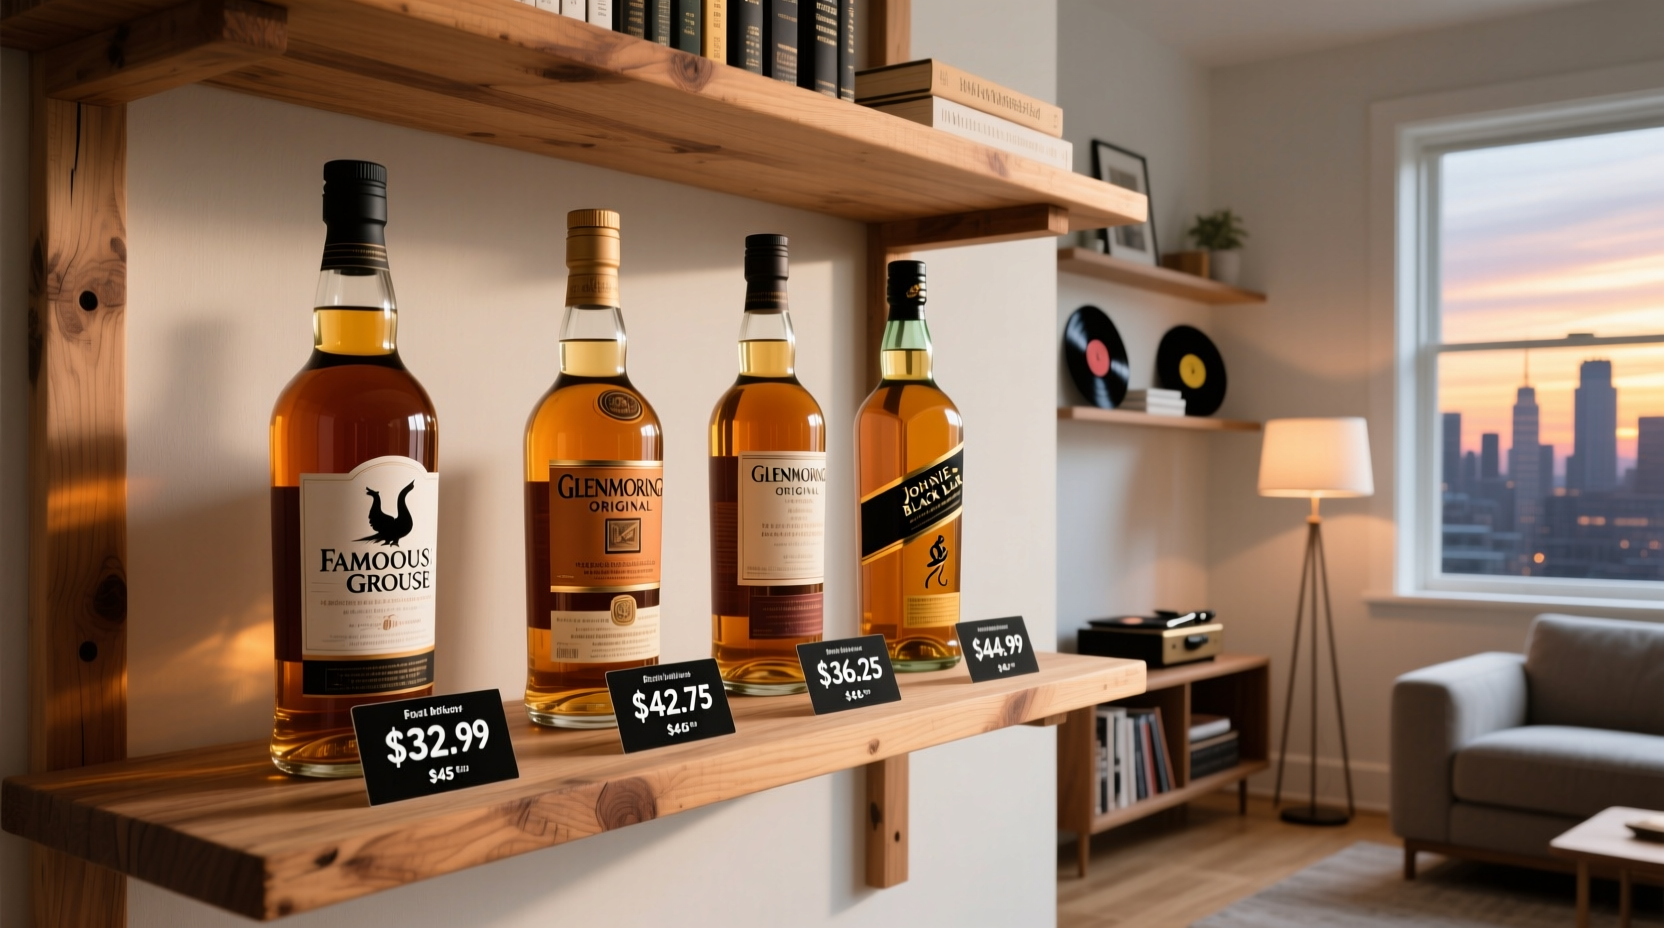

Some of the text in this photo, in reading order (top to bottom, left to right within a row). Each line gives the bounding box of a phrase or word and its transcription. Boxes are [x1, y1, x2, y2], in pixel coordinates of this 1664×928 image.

[589, 500, 653, 513] ORIGINAL
[346, 570, 430, 594] GROUSE
[972, 634, 1023, 662] $44.99
[817, 656, 883, 689] $36.25
[632, 683, 713, 724] $42.75
[385, 719, 490, 768] $32.99
